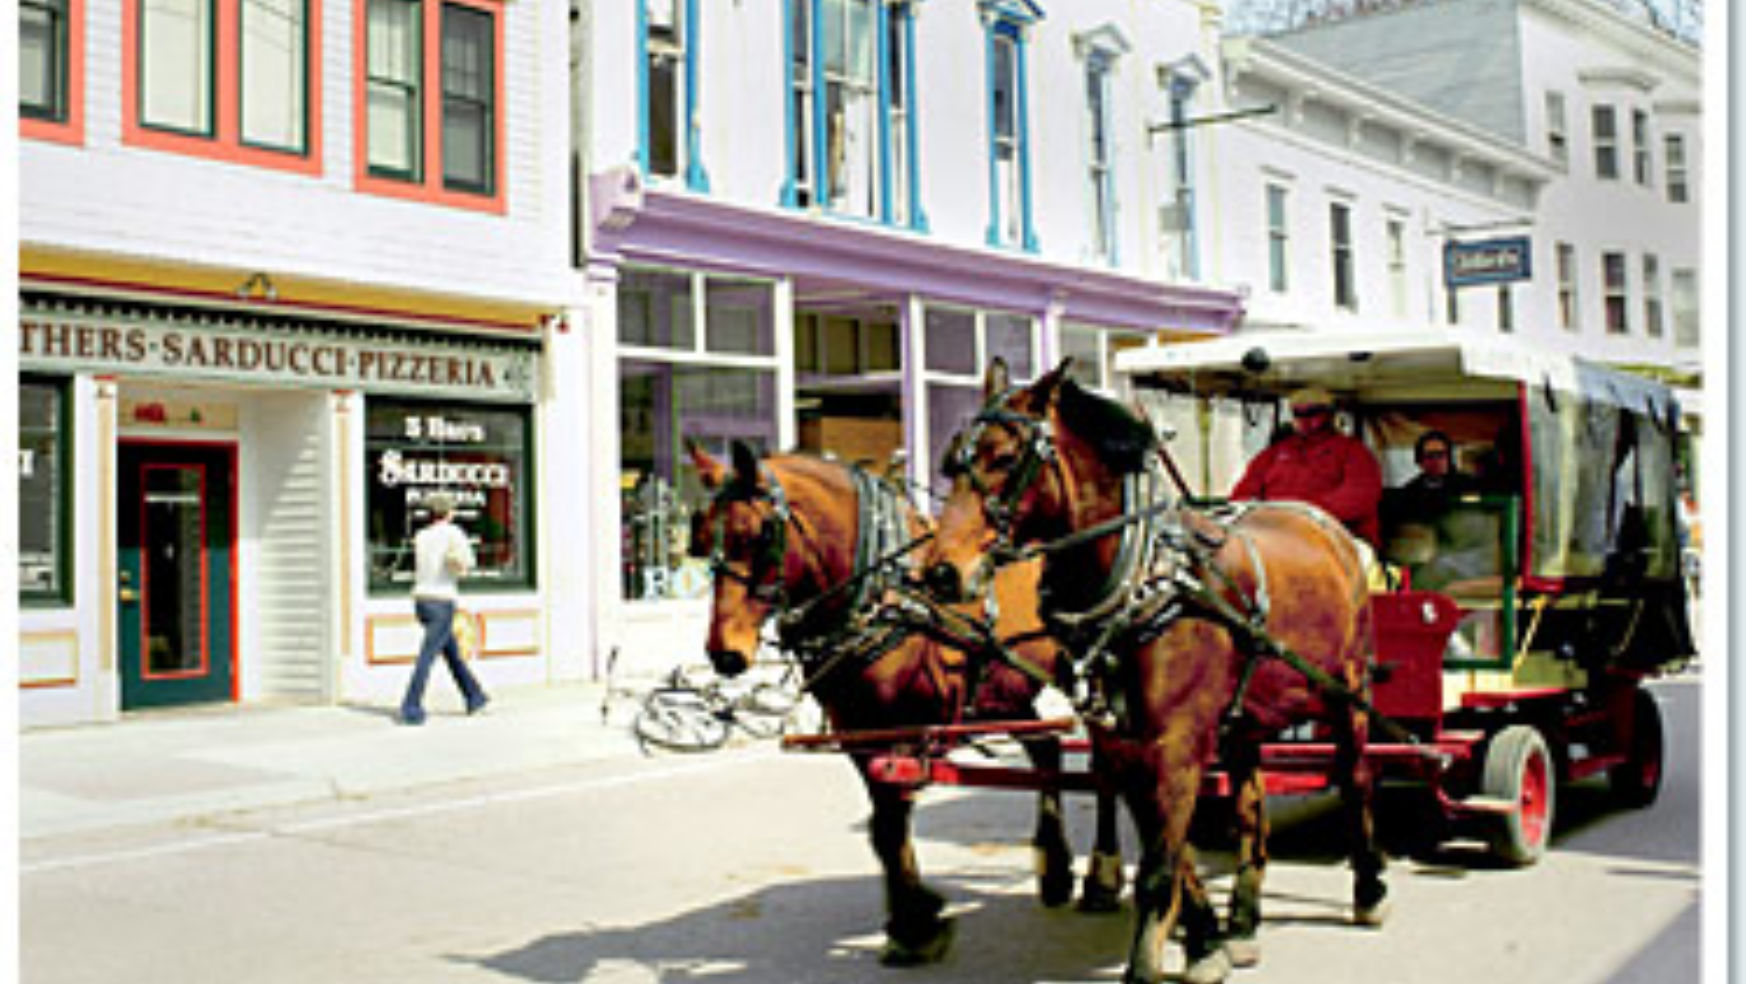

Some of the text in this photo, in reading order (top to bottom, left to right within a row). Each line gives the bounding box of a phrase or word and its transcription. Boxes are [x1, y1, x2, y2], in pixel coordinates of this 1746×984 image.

[19, 320, 495, 388] THERS SARDUCCI PIZZERIA
